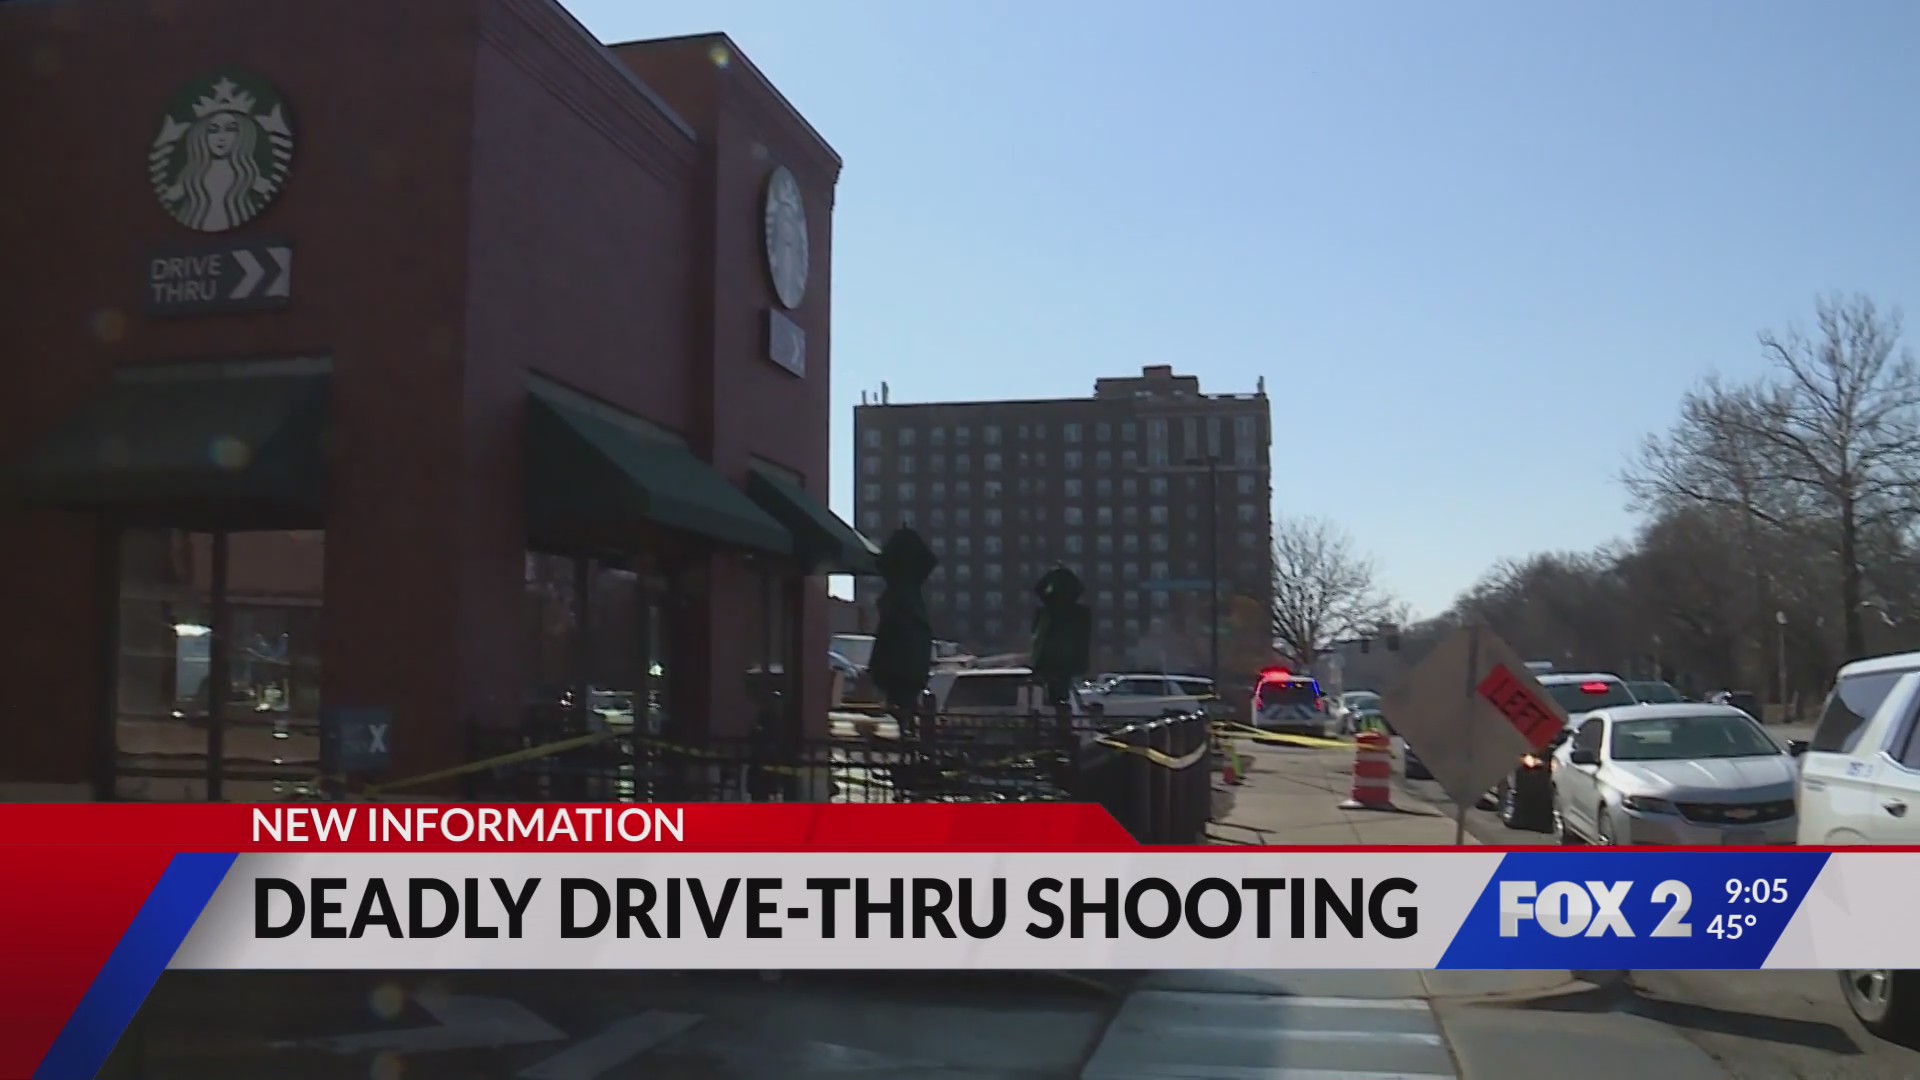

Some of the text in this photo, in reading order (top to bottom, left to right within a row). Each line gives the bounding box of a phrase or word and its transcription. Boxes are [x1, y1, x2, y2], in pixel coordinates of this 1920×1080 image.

[151, 253, 223, 281] DRIVE
[150, 279, 218, 303] THRU
[1486, 677, 1550, 737] LEFT
